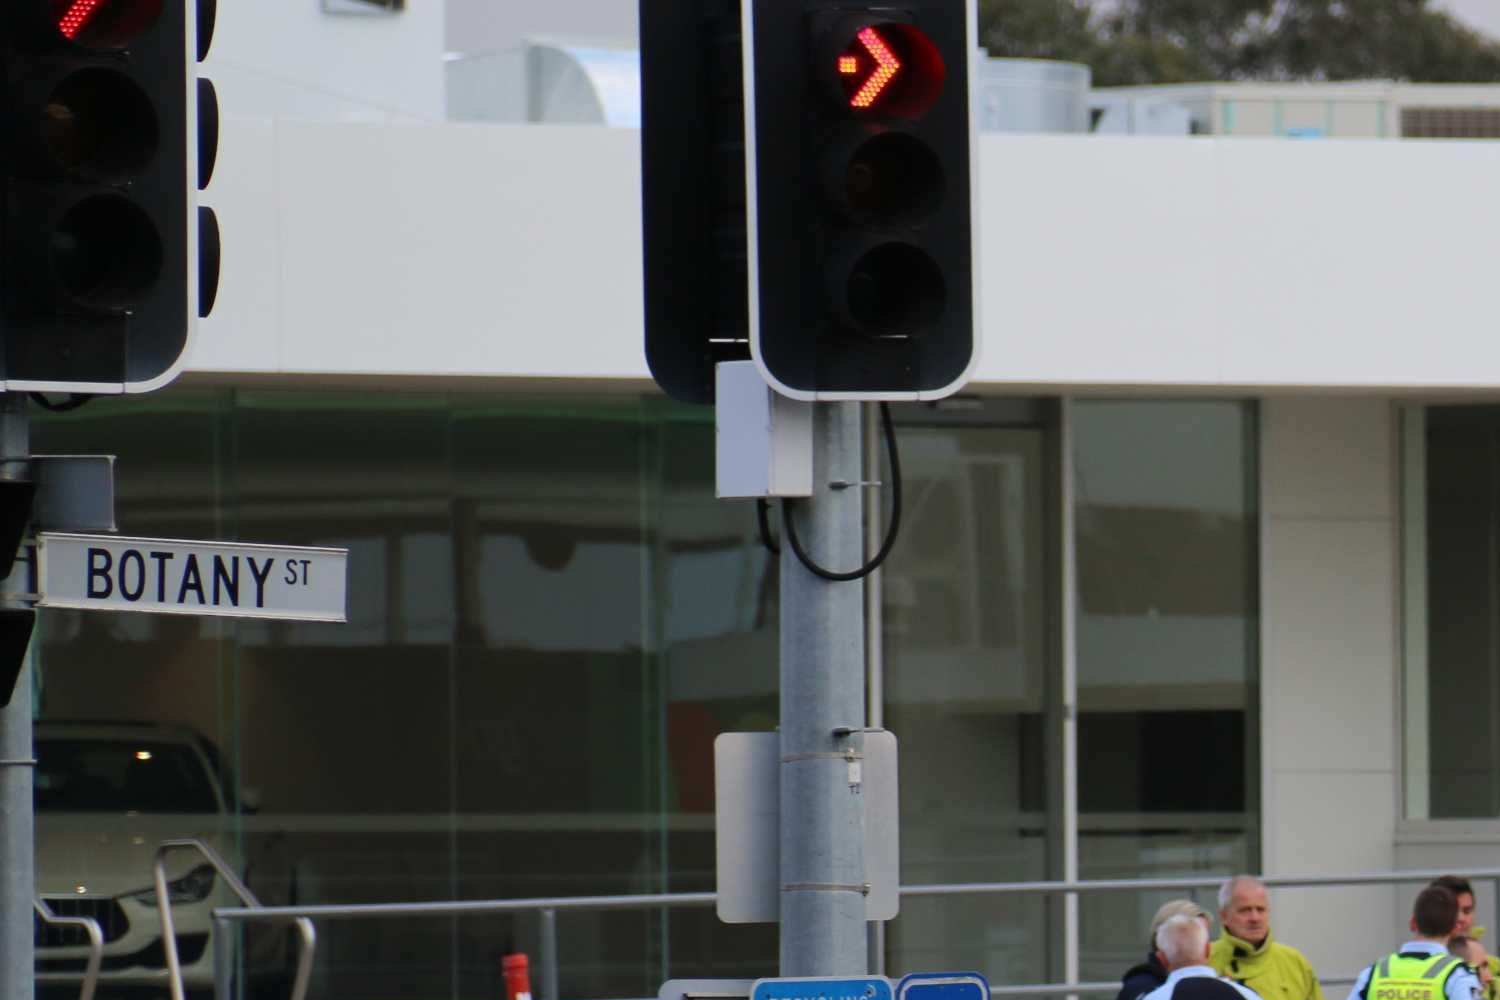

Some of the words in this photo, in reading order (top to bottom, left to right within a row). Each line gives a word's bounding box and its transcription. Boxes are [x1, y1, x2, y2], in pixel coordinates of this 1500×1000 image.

[87, 547, 275, 608] BOTANY
[284, 559, 311, 586] ST
[1376, 988, 1432, 1000] POLICE
